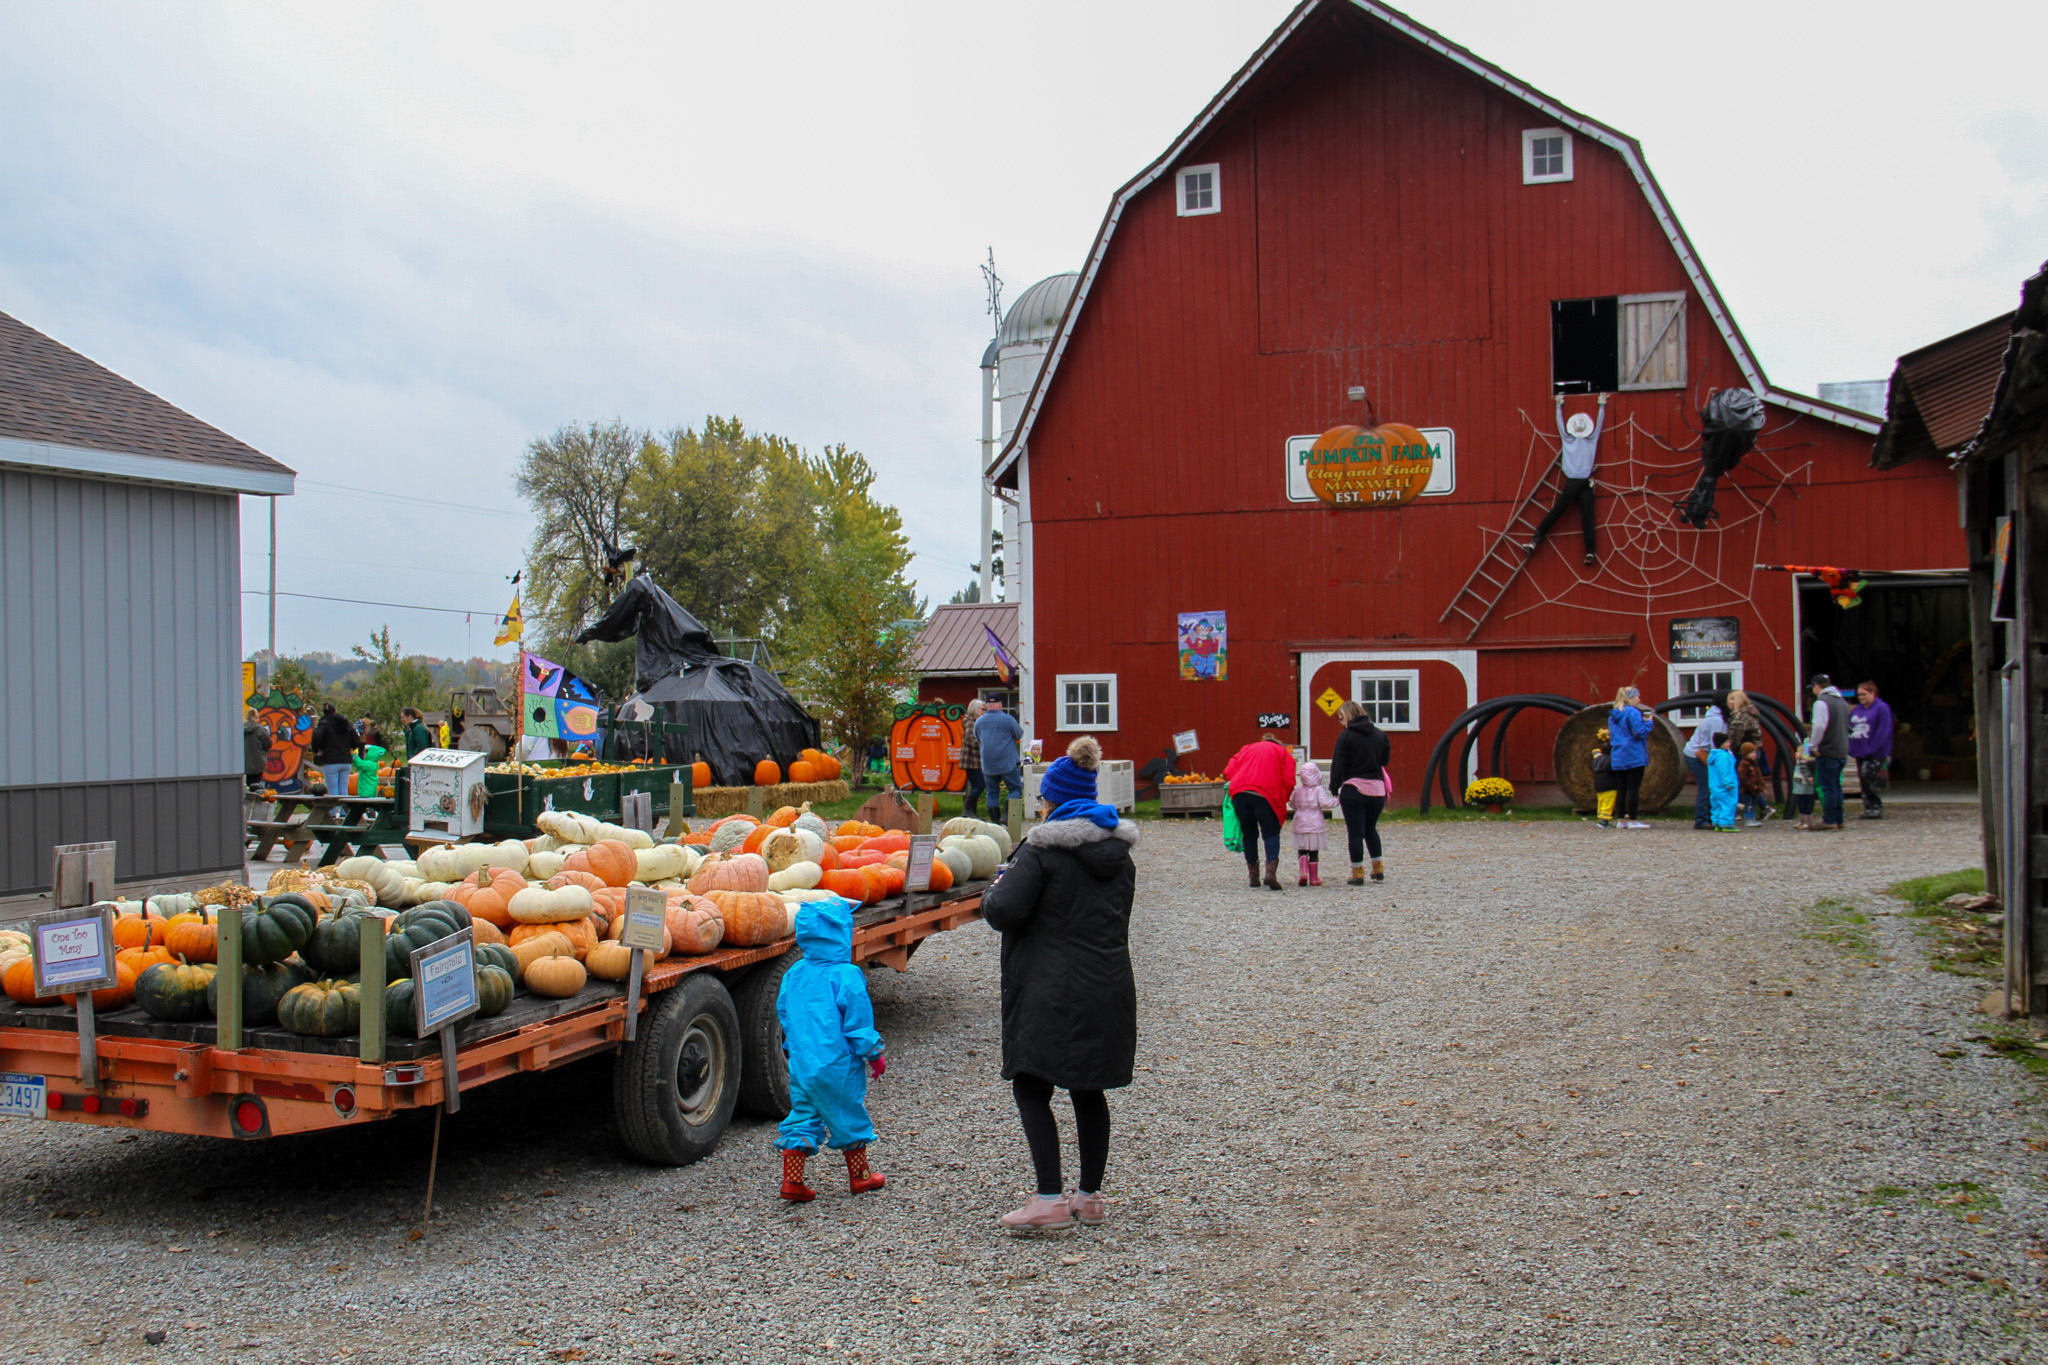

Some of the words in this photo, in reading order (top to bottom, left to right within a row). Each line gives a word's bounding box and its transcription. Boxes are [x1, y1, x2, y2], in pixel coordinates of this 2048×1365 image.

[1352, 435, 1385, 447] The
[1299, 446, 1382, 466] PUMPKIN
[1392, 443, 1442, 461] FARM
[1307, 468, 1343, 481] Clay
[1346, 466, 1378, 478] and
[1381, 463, 1431, 477] Linda
[1324, 478, 1413, 491] MAXWELL
[1335, 491, 1364, 503] EST.
[1370, 490, 1401, 501] 1971
[1672, 640, 1704, 650] Along
[1706, 640, 1737, 648] came
[1259, 713, 1283, 728] Straw
[422, 753, 464, 764] BAGS
[52, 933, 71, 943] One
[71, 928, 88, 940] Too
[59, 943, 83, 955] Many
[429, 954, 463, 977] Fairytale
